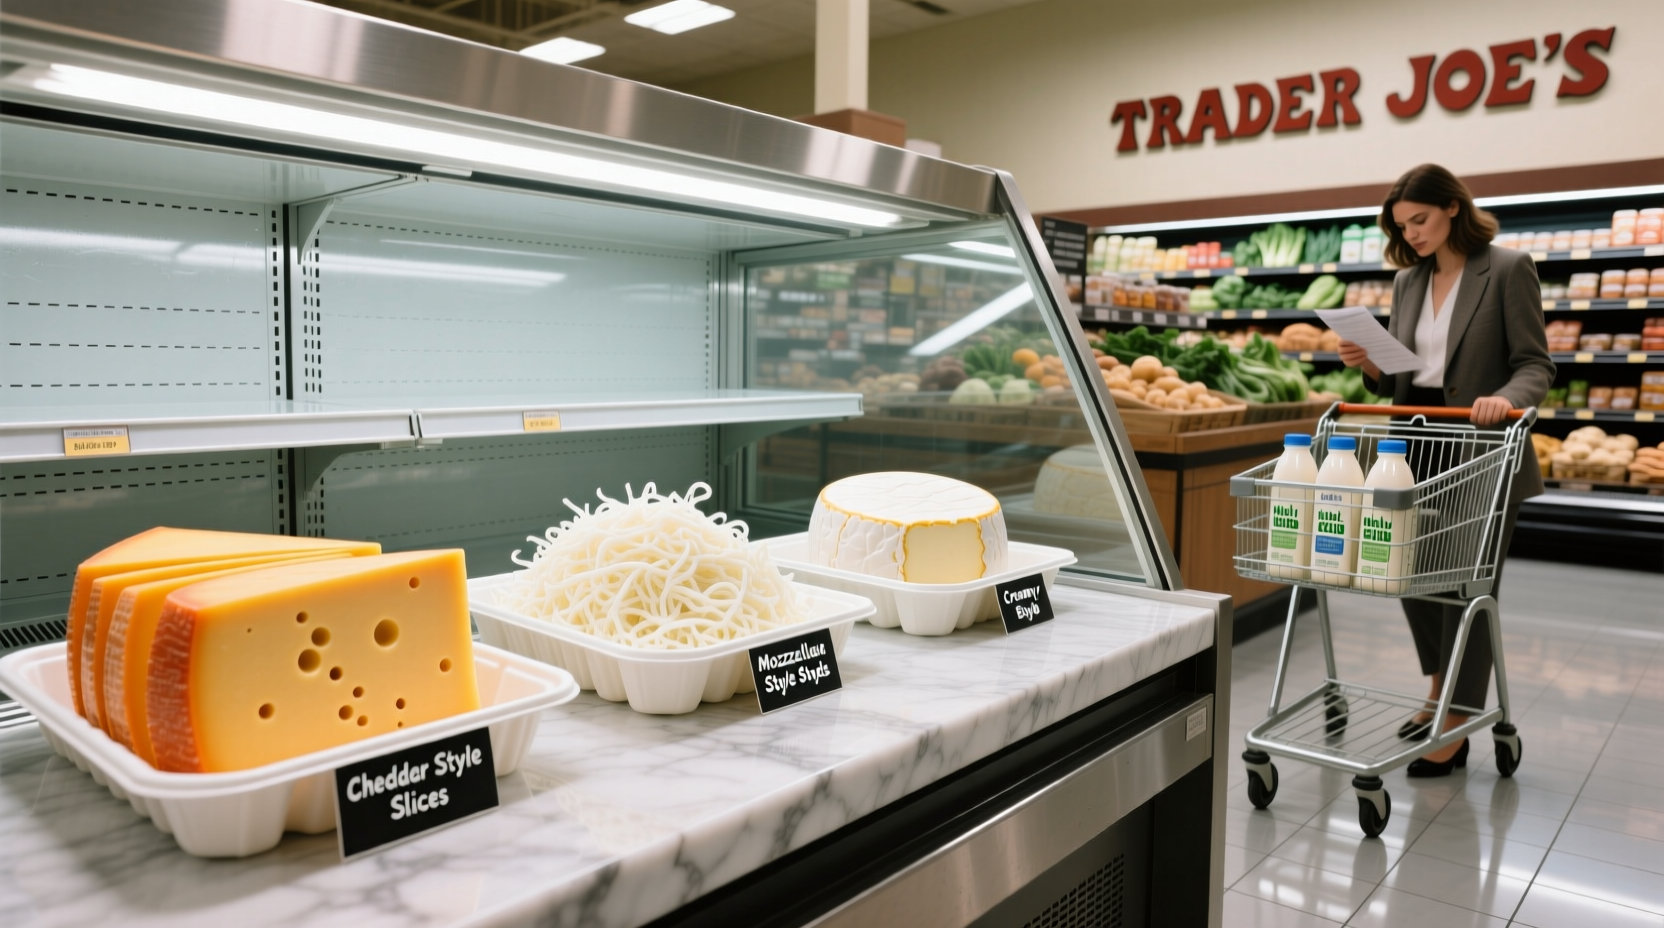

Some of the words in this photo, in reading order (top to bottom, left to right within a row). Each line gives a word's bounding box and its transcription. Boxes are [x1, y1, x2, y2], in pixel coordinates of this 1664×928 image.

[1111, 66, 1363, 153] TRADER
[1386, 25, 1617, 119] JOE'S
[764, 670, 797, 697] Style
[433, 744, 483, 778] Style
[390, 787, 450, 821] Slices
